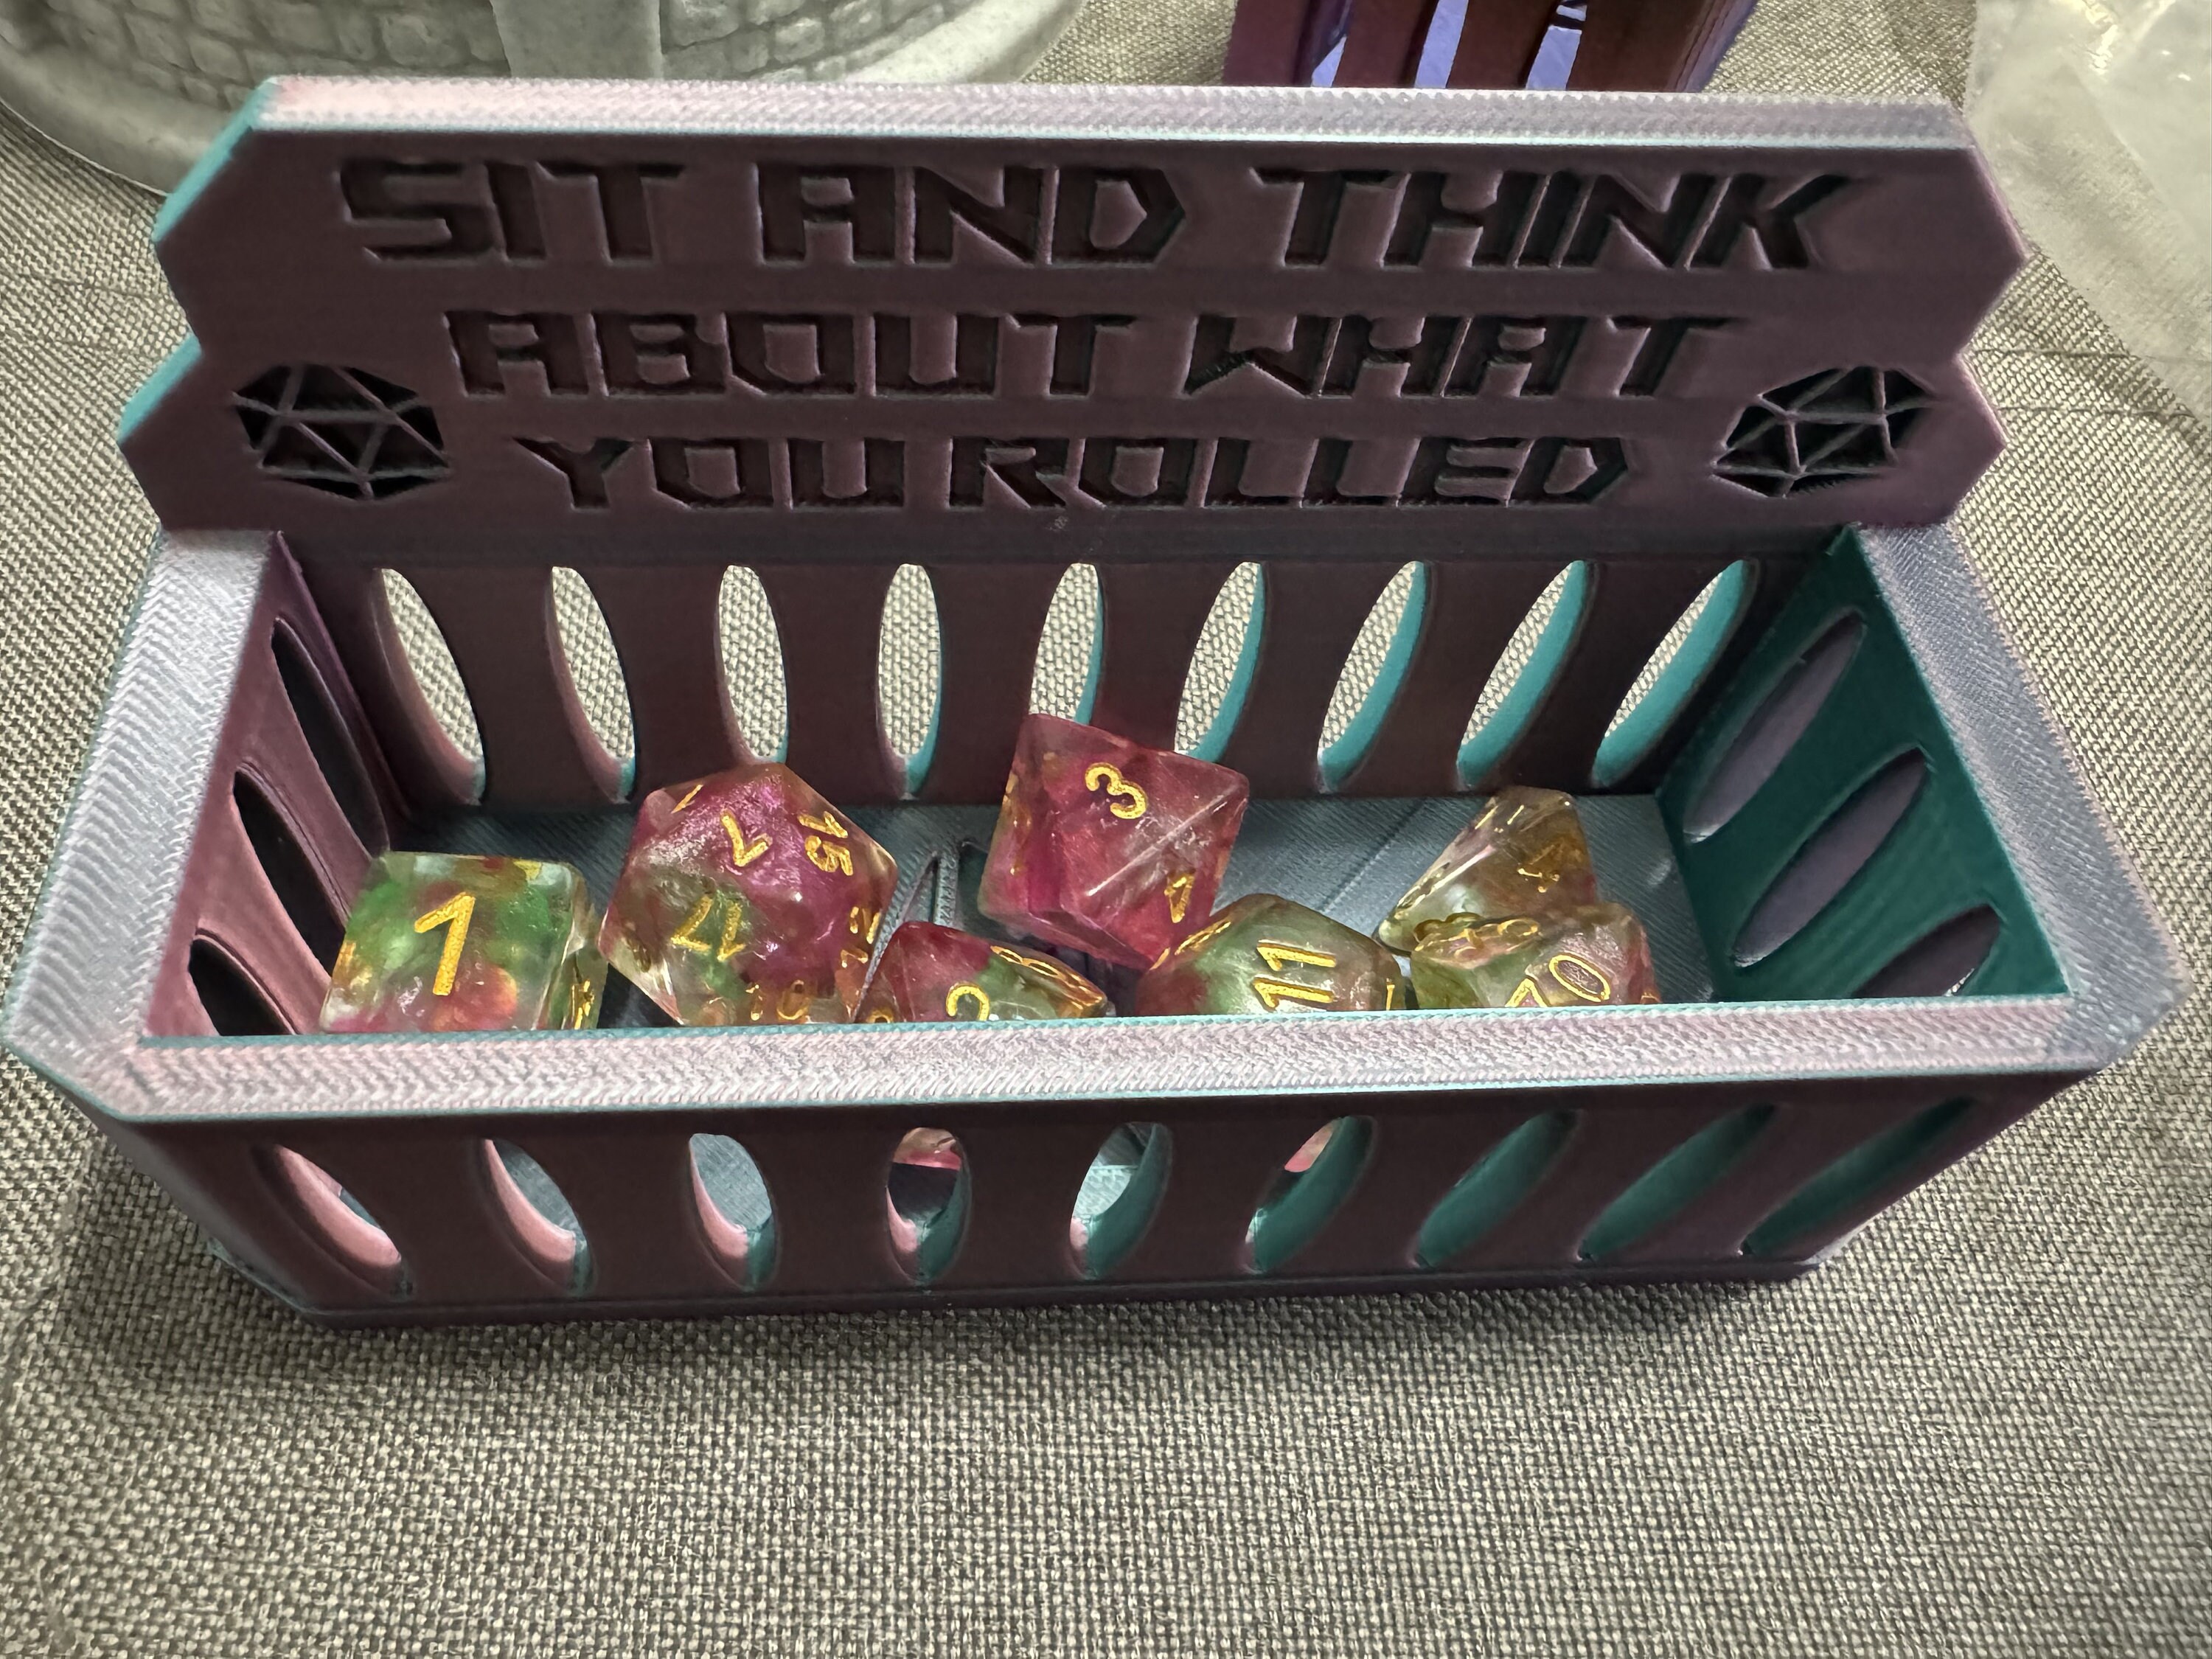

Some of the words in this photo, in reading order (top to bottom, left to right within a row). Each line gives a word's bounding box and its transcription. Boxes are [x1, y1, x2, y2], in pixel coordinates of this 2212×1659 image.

[336, 156, 687, 264] SIT
[751, 162, 1187, 267] AND
[1248, 167, 1857, 271] THINK
[442, 308, 1137, 400] ABOUT
[1178, 313, 1736, 400] WHAT
[512, 435, 908, 513] YOU
[948, 435, 1630, 510] ROLLED
[1085, 762, 1147, 820] 3
[720, 810, 773, 868] 7
[797, 810, 854, 877] 15
[414, 891, 476, 996] 1
[1252, 938, 1337, 1012] 11
